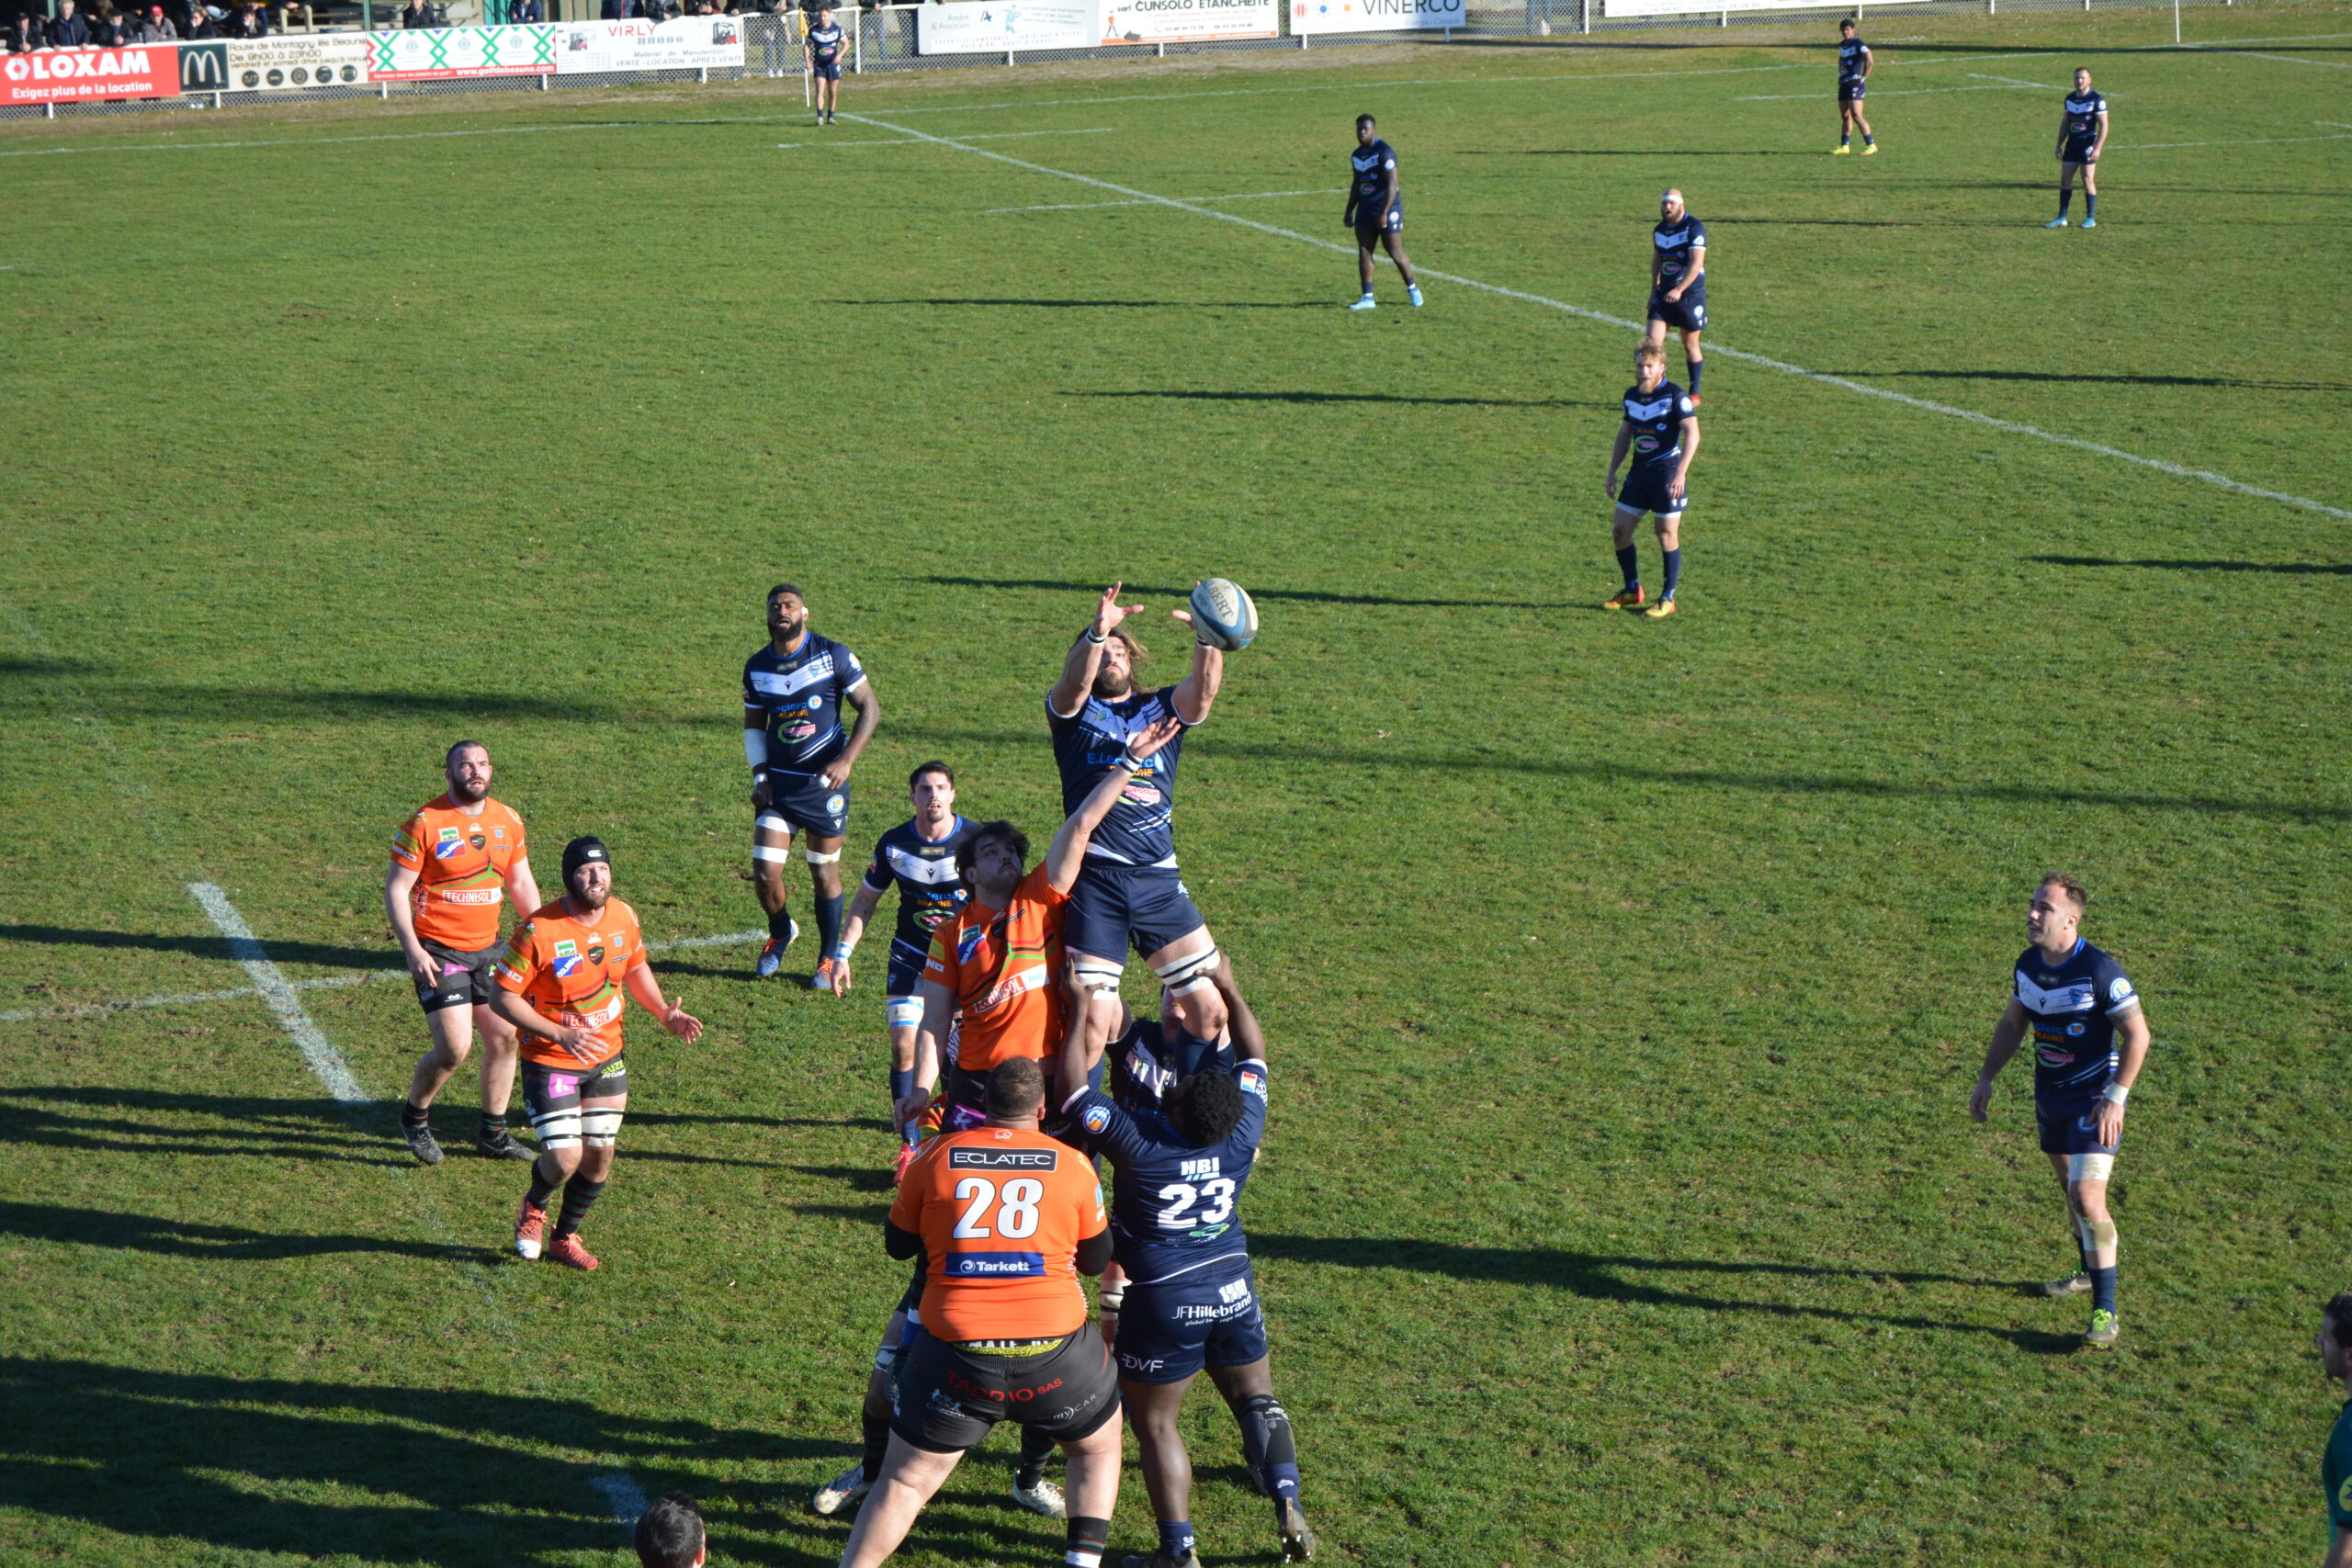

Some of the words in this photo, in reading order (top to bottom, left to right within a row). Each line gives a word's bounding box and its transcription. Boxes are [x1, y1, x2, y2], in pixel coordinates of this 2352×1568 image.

[1363, 0, 1461, 15] VINERCO
[608, 24, 657, 37] VIRLY
[230, 43, 254, 51] Route
[257, 42, 269, 51] de
[271, 40, 315, 50] Montagny
[230, 53, 244, 62] De
[288, 50, 322, 59] 23h00
[33, 51, 151, 80] LOXAM
[456, 65, 555, 76] www.golfdebeaune.com
[12, 87, 50, 100] Exigez
[51, 85, 76, 99] plus
[78, 85, 92, 96] de
[95, 84, 106, 94] la
[108, 82, 153, 94] location
[954, 1152, 1053, 1166] ECLATEC
[1181, 1157, 1220, 1176] HBI
[953, 1177, 1045, 1239] 28
[1158, 1178, 1236, 1229] 23
[976, 1261, 1030, 1271] Tarkett
[1184, 1318, 1205, 1327] global
[946, 1369, 1035, 1403] TADDIO
[1036, 1378, 1064, 1394] SAS
